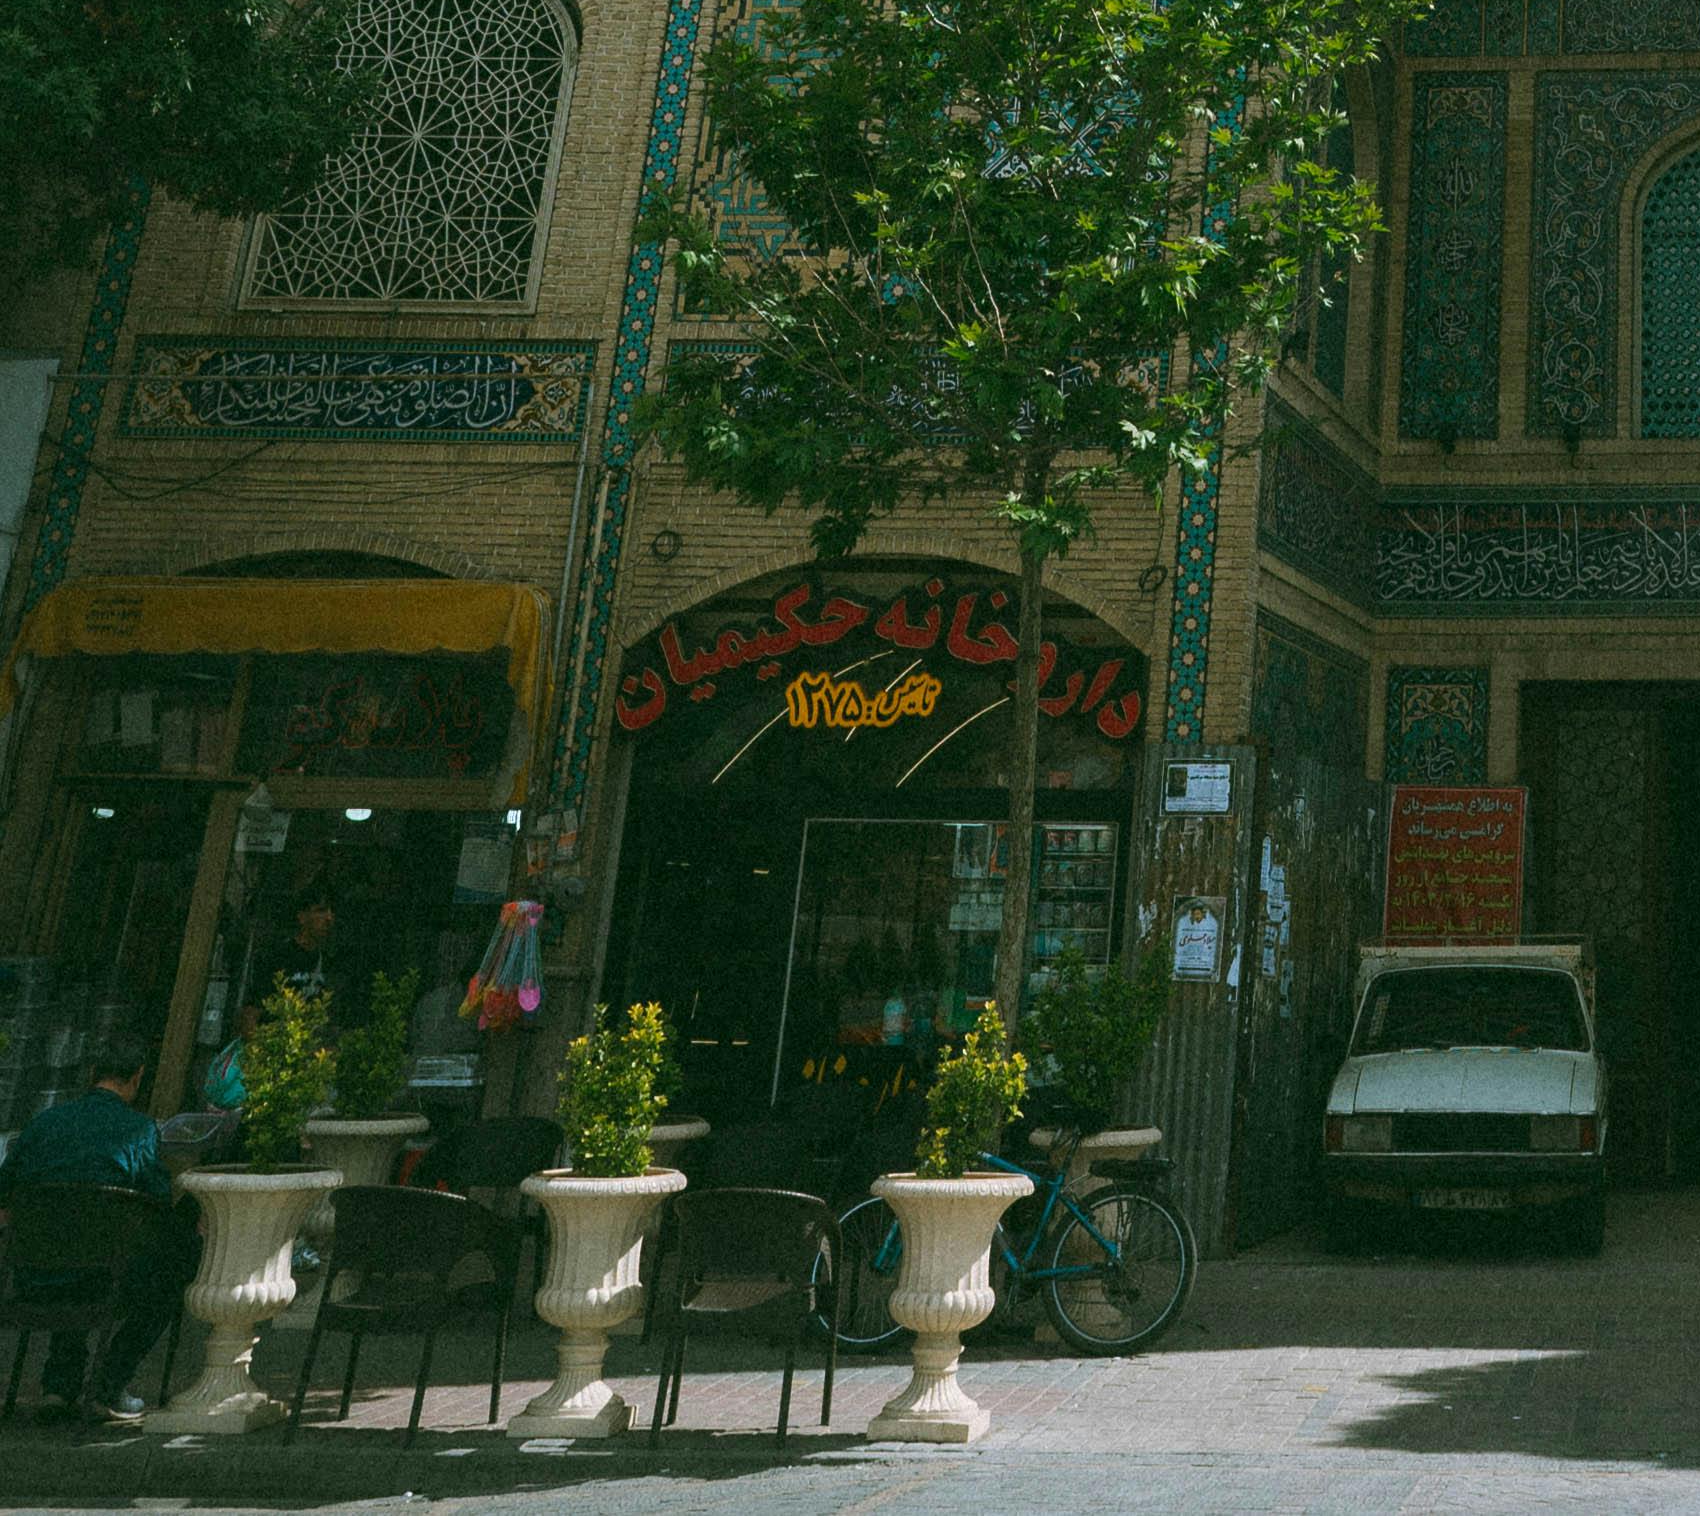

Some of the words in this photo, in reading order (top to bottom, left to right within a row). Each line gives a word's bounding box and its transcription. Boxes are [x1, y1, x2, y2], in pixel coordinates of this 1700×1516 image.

[615, 582, 870, 732] حکیمیان
[872, 575, 1143, 740] داروخانه
[1401, 796, 1467, 817] همشهریان
[1466, 797, 1500, 817] اطلاع
[1459, 822, 1505, 841] گرامی
